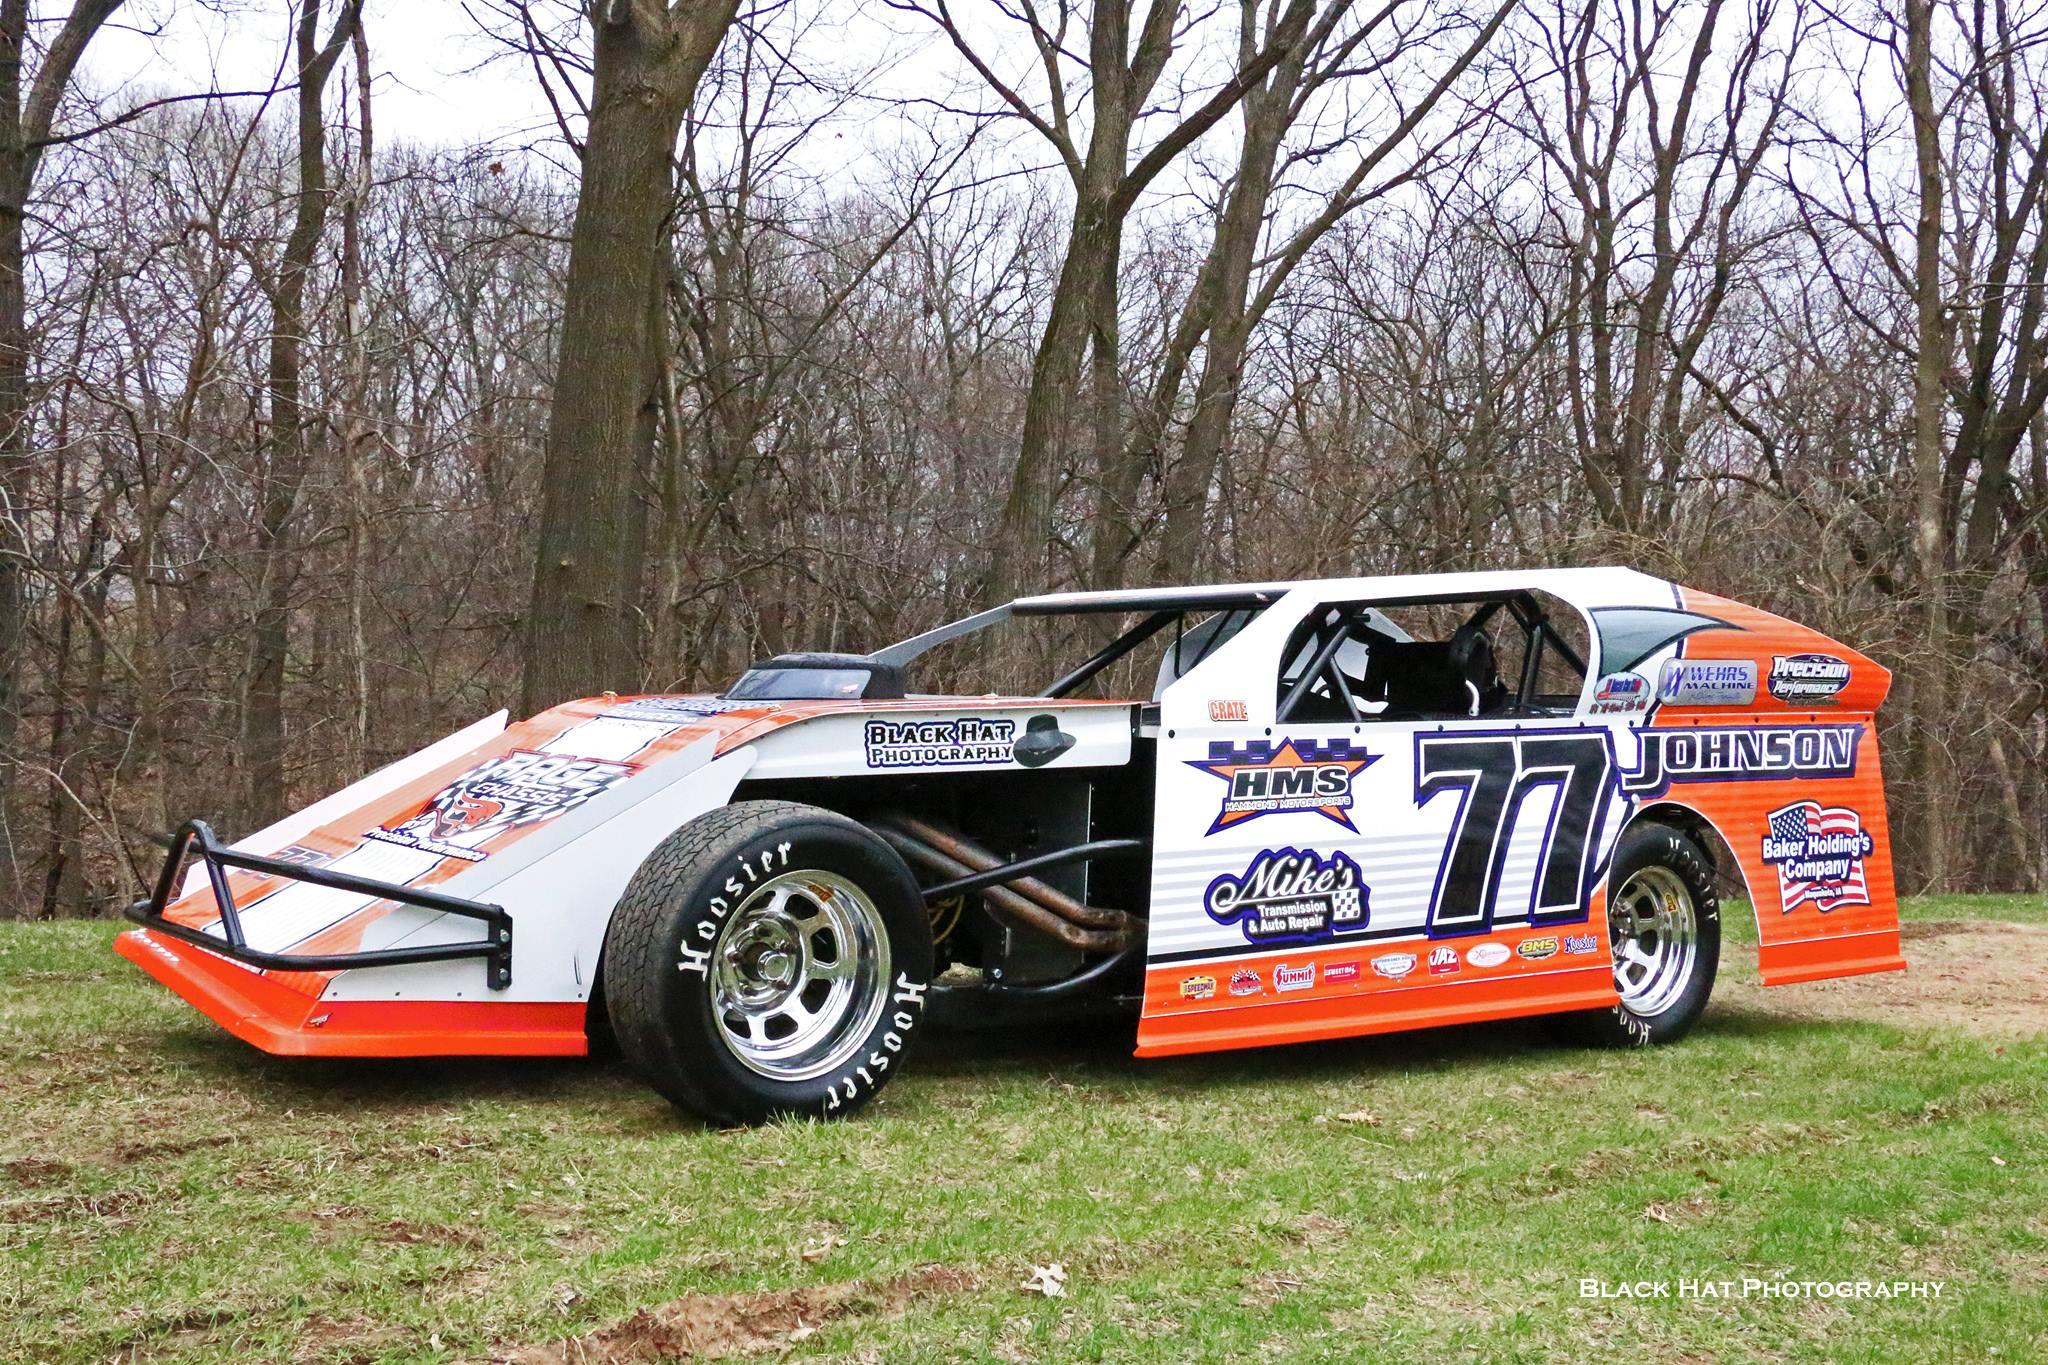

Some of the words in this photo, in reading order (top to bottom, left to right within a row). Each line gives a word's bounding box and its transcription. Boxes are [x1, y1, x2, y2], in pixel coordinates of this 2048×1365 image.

[1690, 666, 1748, 681] WEHRS
[1772, 656, 1849, 678] Precision
[1684, 682, 1754, 690] MACHINE
[1773, 680, 1839, 697] Performance
[1210, 702, 1247, 720] CRATE
[870, 726, 952, 745] BLACK
[961, 723, 1012, 742] HAT
[872, 746, 1012, 763] PHOTOGRAPHY
[1621, 729, 1857, 792] JOHNSON
[476, 752, 630, 789] RAGE
[470, 781, 564, 805] CHASSIS
[1232, 767, 1348, 799] HMS
[1226, 800, 1277, 812] HAMMOND
[1280, 796, 1350, 809] MOTORSPORTS
[1415, 730, 1614, 936] 77
[1762, 838, 1806, 858] Baker
[1808, 832, 1870, 856] Holding's
[1785, 858, 1850, 881] Company
[1211, 855, 1354, 914] Mike's
[678, 840, 793, 983] Hoosier
[1258, 901, 1327, 917] Transmission
[1249, 920, 1258, 933] &
[1260, 918, 1287, 932] Auto
[1288, 915, 1324, 931] Repair
[1522, 939, 1557, 952] BMS
[1564, 935, 1597, 952] Hoosier
[1431, 947, 1458, 965] JAZ
[1612, 1005, 1652, 1046] Hoos
[827, 972, 928, 1110] Hoosier
